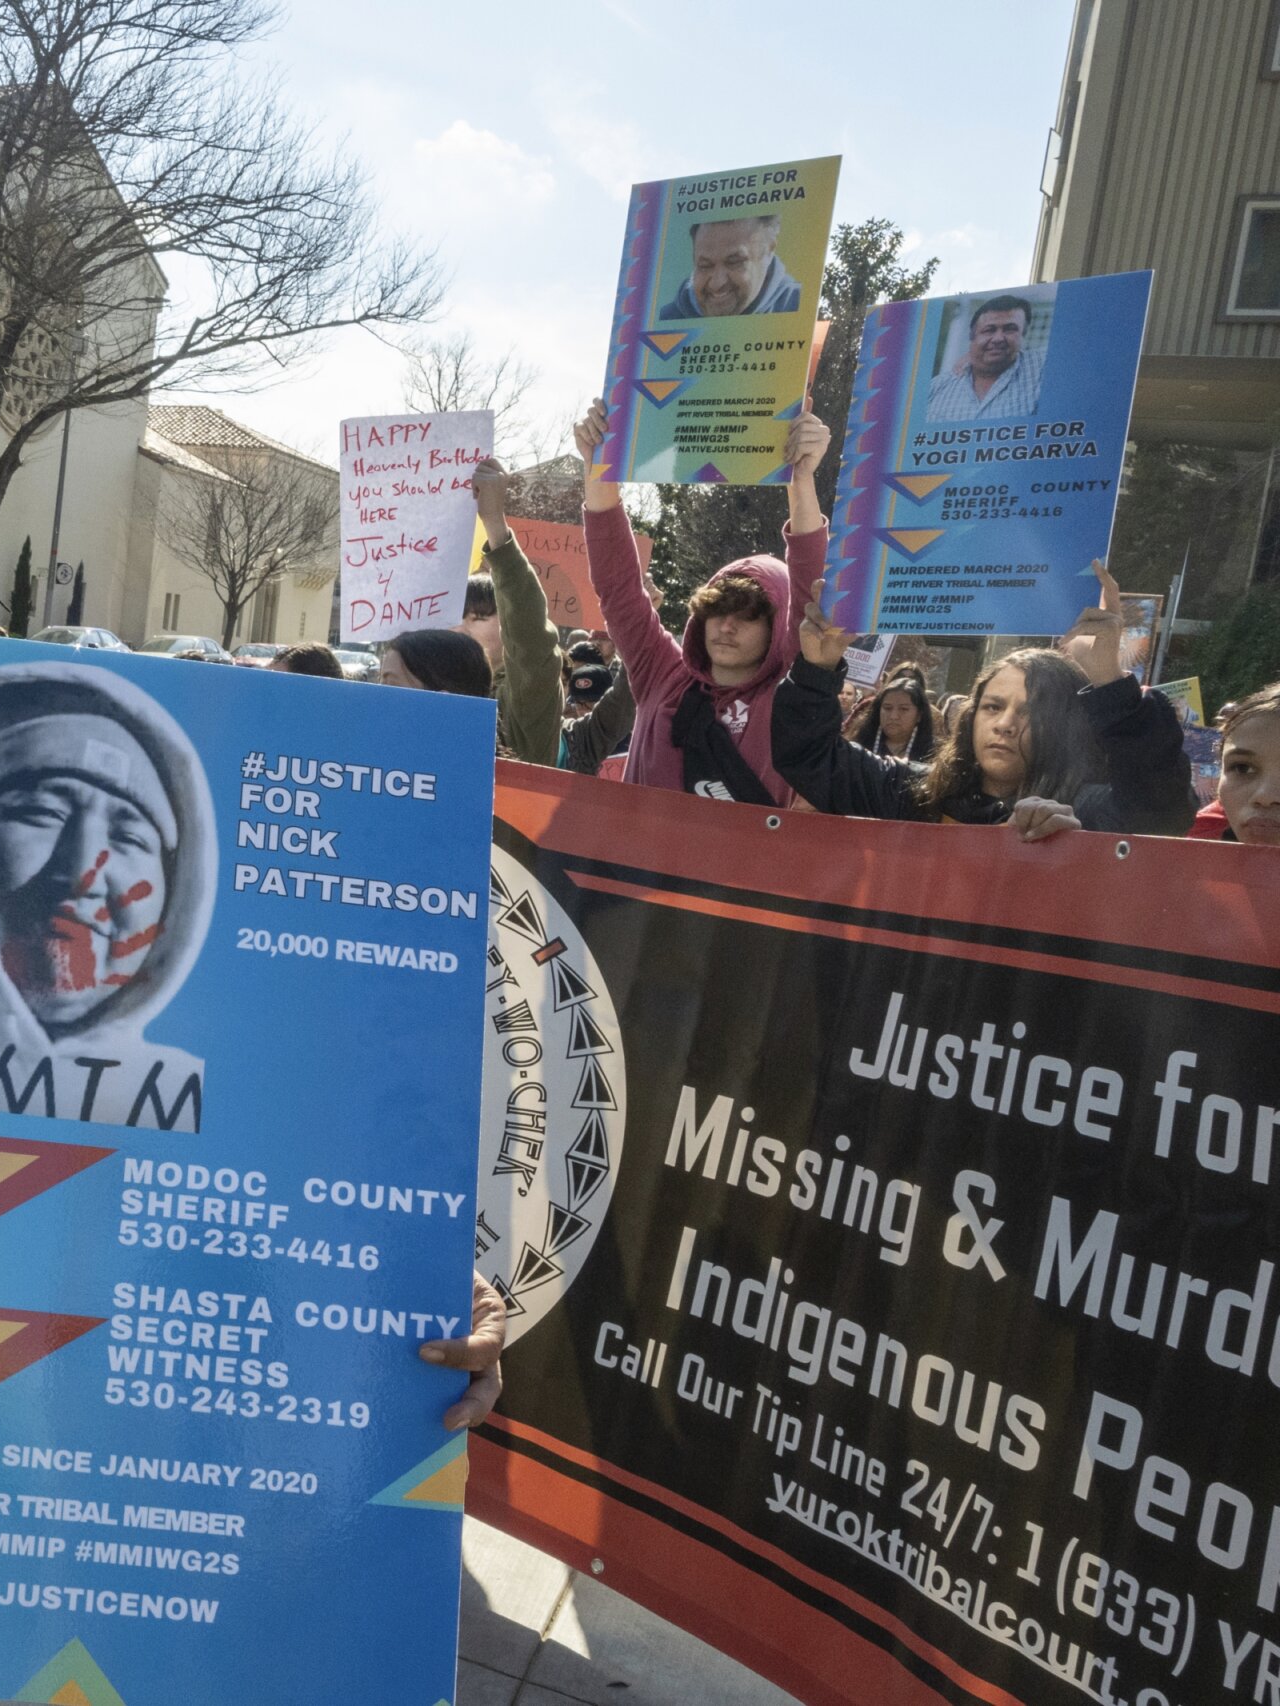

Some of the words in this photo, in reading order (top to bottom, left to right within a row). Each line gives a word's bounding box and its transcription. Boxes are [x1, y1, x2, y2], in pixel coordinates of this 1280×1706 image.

[678, 174, 758, 197] #JUSTICE
[762, 169, 798, 186] FOR
[676, 198, 715, 214] YOGI
[720, 186, 806, 209] MCGARVA
[680, 353, 740, 364] SHERIFF
[681, 344, 730, 354] MODOC
[744, 340, 805, 351] COUNTY
[679, 362, 775, 374] 530-233-4416
[343, 422, 432, 453] HAPPY
[673, 434, 729, 442] #MMIWG2S
[675, 425, 709, 433] #MMIW
[913, 425, 1027, 447] #JUSTICE
[1034, 421, 1086, 438] FOR
[911, 450, 973, 467] YOGI
[974, 441, 1098, 463] MCGARVA
[451, 478, 473, 490] be
[944, 485, 1010, 498] MODOC
[1030, 479, 1112, 494] COUNTY
[359, 507, 398, 525] HERE
[940, 506, 1063, 521] 530-233-4416
[942, 496, 1020, 509] SHERIFF
[346, 533, 438, 567] Justice
[377, 569, 393, 597] 4
[886, 579, 910, 589] #PIT
[910, 579, 944, 589] RIVER
[945, 579, 984, 588] TRIBAL
[986, 578, 1036, 588] MEMBER
[888, 565, 961, 576] MURDERED
[963, 564, 1013, 575] MARCH
[1015, 563, 1049, 574] 2020
[350, 591, 449, 632] DANTE
[880, 604, 952, 614] #MMIWG2S
[883, 595, 928, 604] #MMIW
[931, 594, 975, 604] #MMIP
[877, 622, 995, 631] #NATIVEJUSTICENOW
[241, 751, 438, 801] #JUSTICE
[240, 782, 321, 819] FOR
[236, 820, 341, 860] NICK
[233, 863, 478, 920] PATTERSON
[236, 927, 329, 958] 20,000
[335, 939, 459, 973] REWARD
[848, 991, 1124, 1142] Justice
[123, 1157, 268, 1196] MODOC
[302, 1177, 466, 1219] COUNTY
[664, 1084, 922, 1266] Missing
[942, 1169, 1007, 1283] &
[120, 1189, 289, 1230] SHERIFF
[117, 1219, 380, 1271] 530-233-4416
[112, 1282, 273, 1323] SHASTA
[294, 1301, 461, 1340] COUNTY
[109, 1313, 269, 1355] SECRET
[666, 1226, 1047, 1472] Indigenous
[107, 1345, 290, 1389] WITNESS
[103, 1377, 371, 1429] 530-243-2319
[1, 1444, 93, 1474] SINCE
[99, 1454, 243, 1488] JANUARY
[249, 1468, 319, 1496] 2020
[594, 1321, 668, 1389] Call
[677, 1352, 744, 1419] Our
[752, 1383, 803, 1457] Tip
[810, 1413, 887, 1498] Line
[900, 1458, 1003, 1565] 24/7:
[1016, 1520, 1045, 1587] 1
[1056, 1536, 1197, 1677] (833)
[17, 1494, 118, 1527] TRIBAL
[123, 1504, 246, 1538] MEMBER
[74, 1539, 241, 1576] #MMIWG2S
